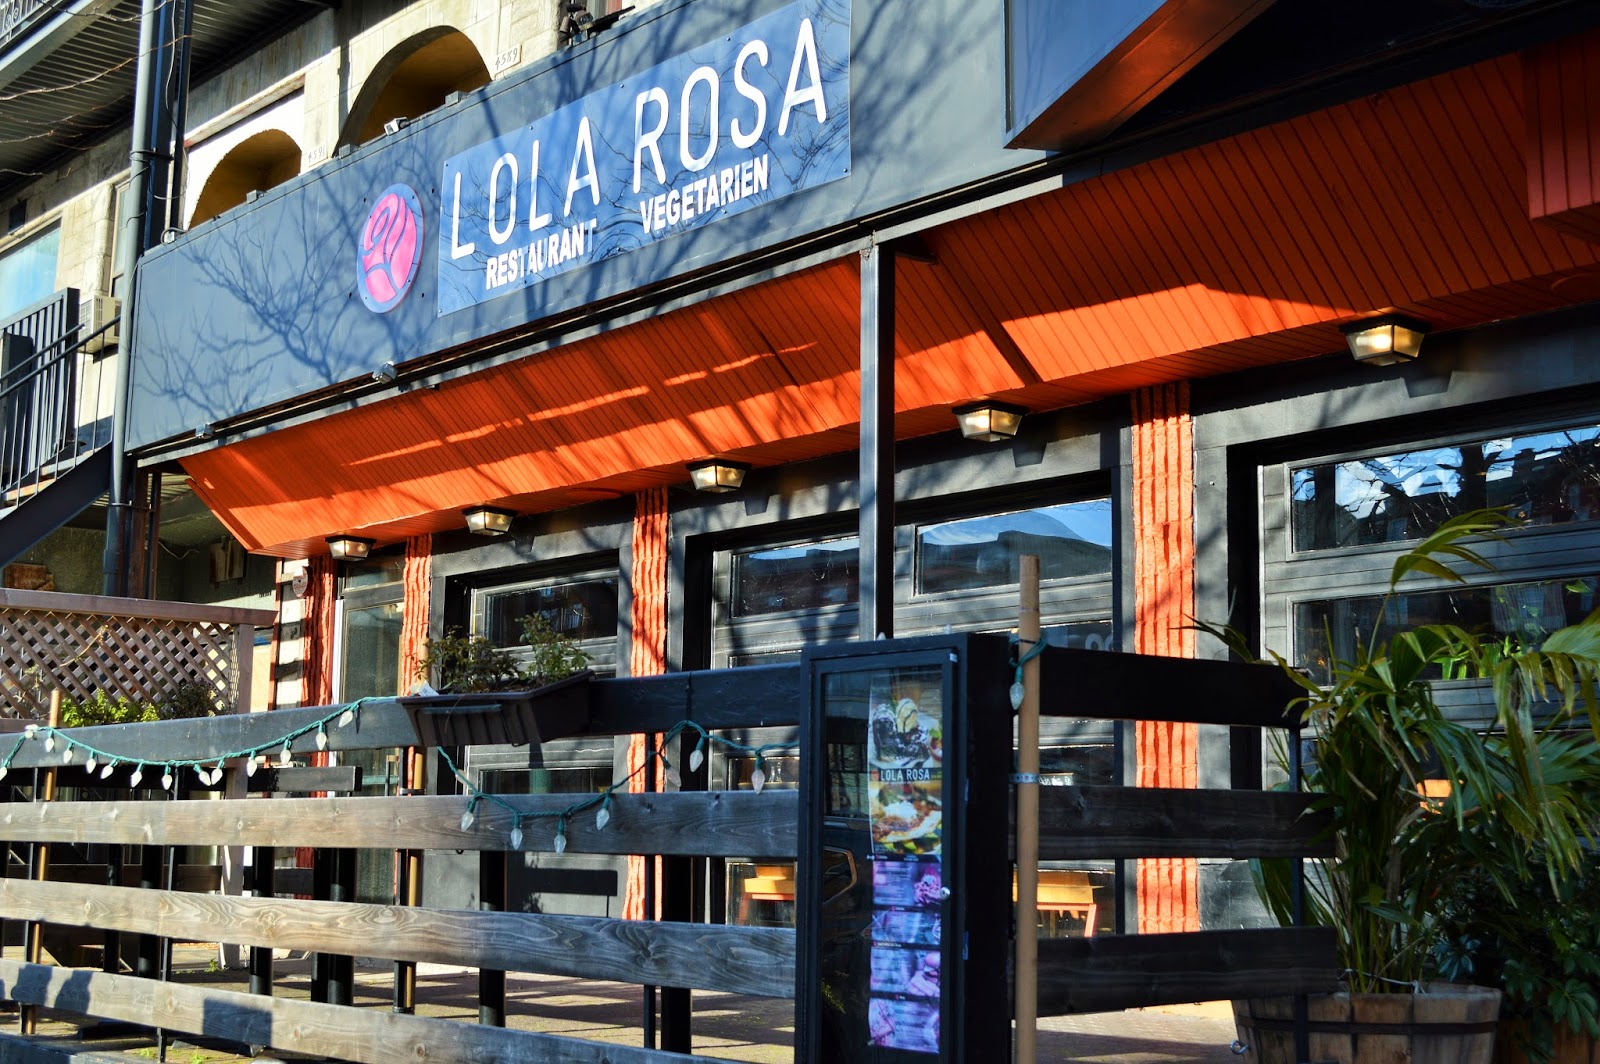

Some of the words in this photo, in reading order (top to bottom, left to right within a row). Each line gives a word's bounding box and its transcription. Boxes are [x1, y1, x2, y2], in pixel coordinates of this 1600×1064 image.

[495, 47, 518, 71] 4589
[451, 116, 600, 260] LOLA
[633, 17, 827, 194] ROSA
[485, 218, 597, 290] RESTAURANT
[639, 153, 769, 234] VEGETARIEN
[881, 769, 904, 781] LOLA
[906, 768, 930, 780] ROSA
